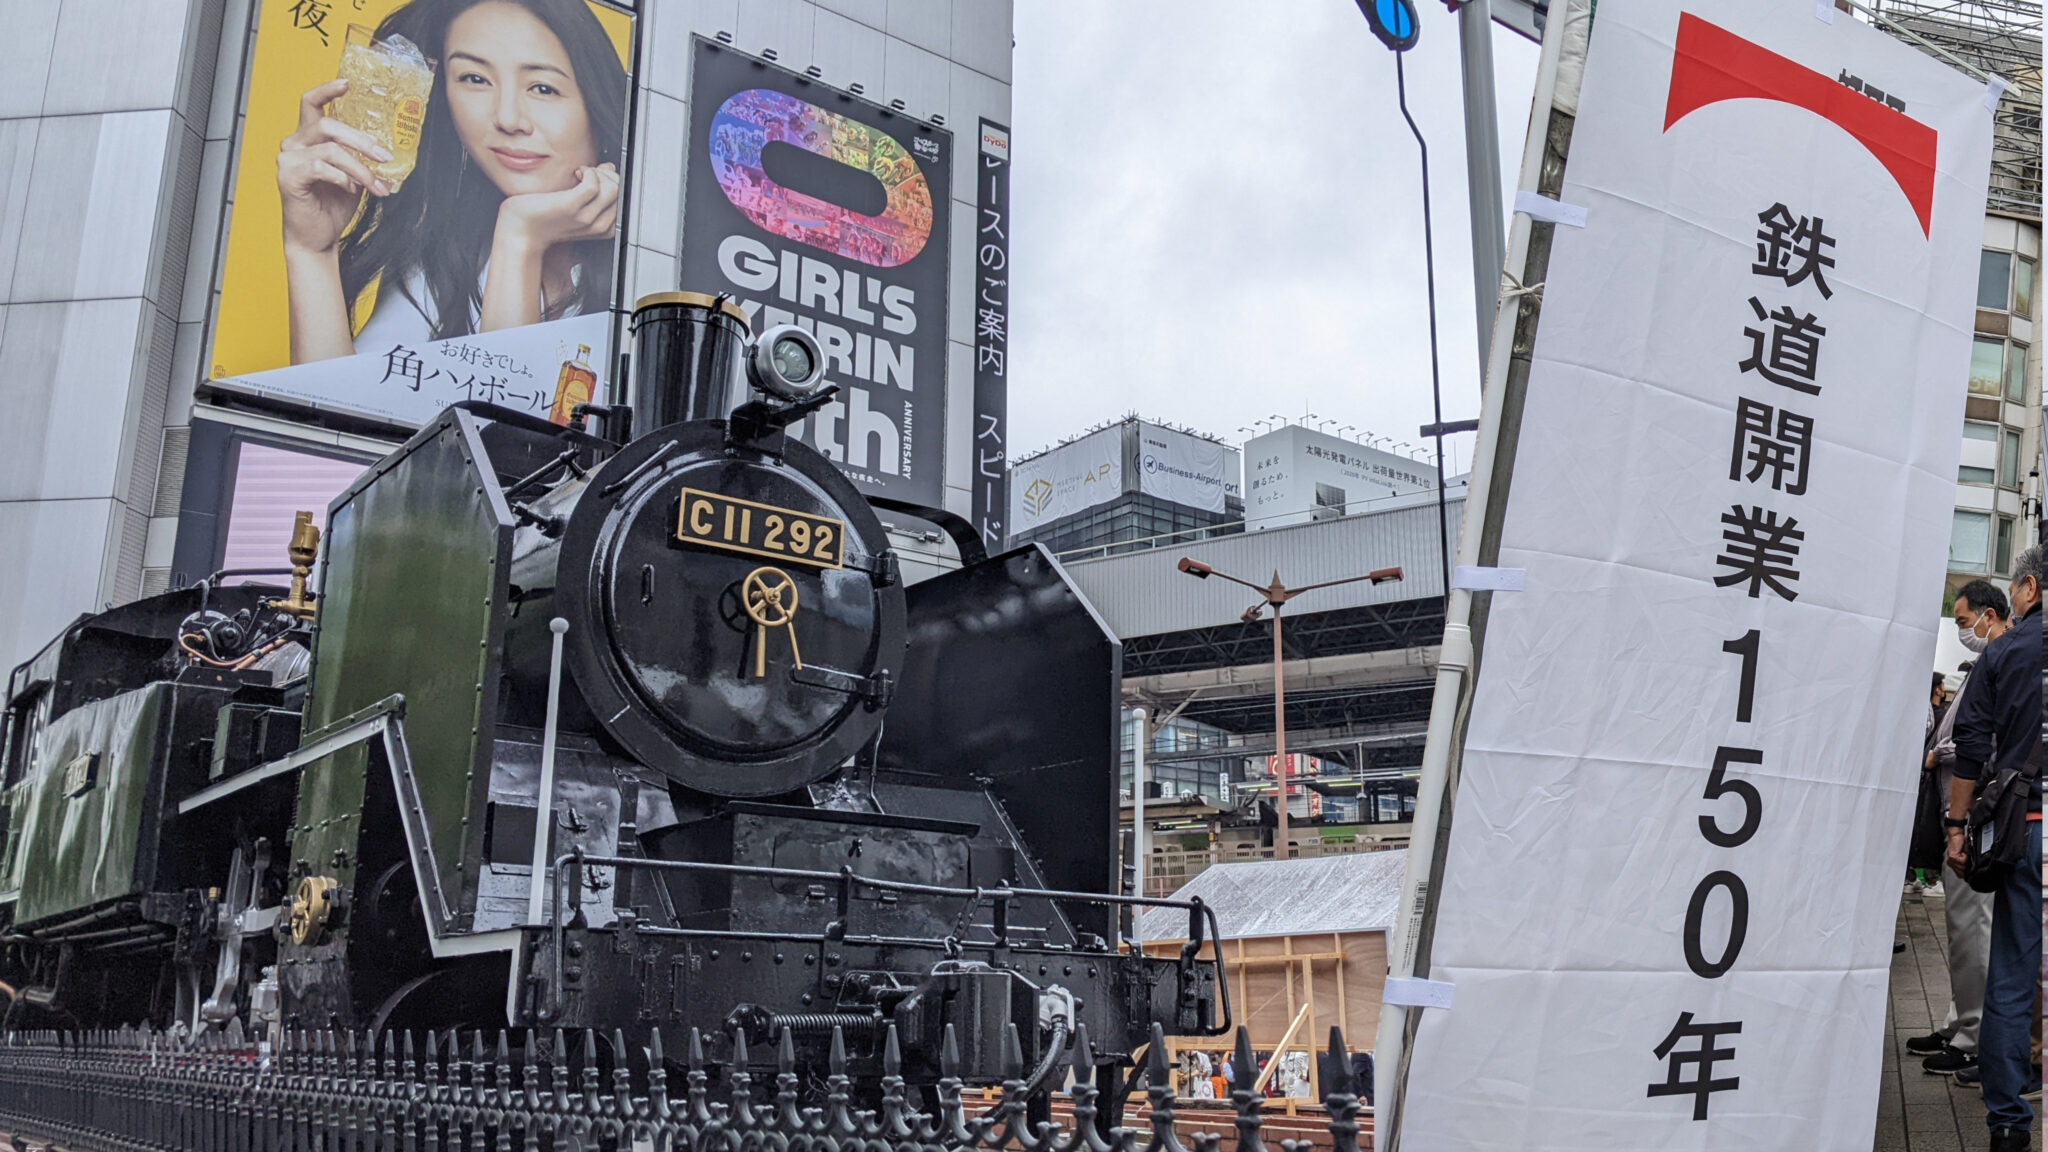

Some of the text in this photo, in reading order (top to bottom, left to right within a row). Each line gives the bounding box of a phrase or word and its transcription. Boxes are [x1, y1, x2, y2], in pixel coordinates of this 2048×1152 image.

[984, 135, 1006, 149] DyDo
[717, 235, 917, 335] GIRL'S
[380, 344, 558, 411] 角ハイボール
[441, 341, 534, 379] お好きでしょ。
[902, 400, 913, 480] ANNIVERSARY
[1305, 444, 1369, 470] 太陽光発電パネル
[1084, 463, 1111, 486] AP
[1158, 462, 1221, 487] Business-Airport
[764, 515, 833, 560] 292
[1647, 202, 1836, 1121] 鉄道開業150年
